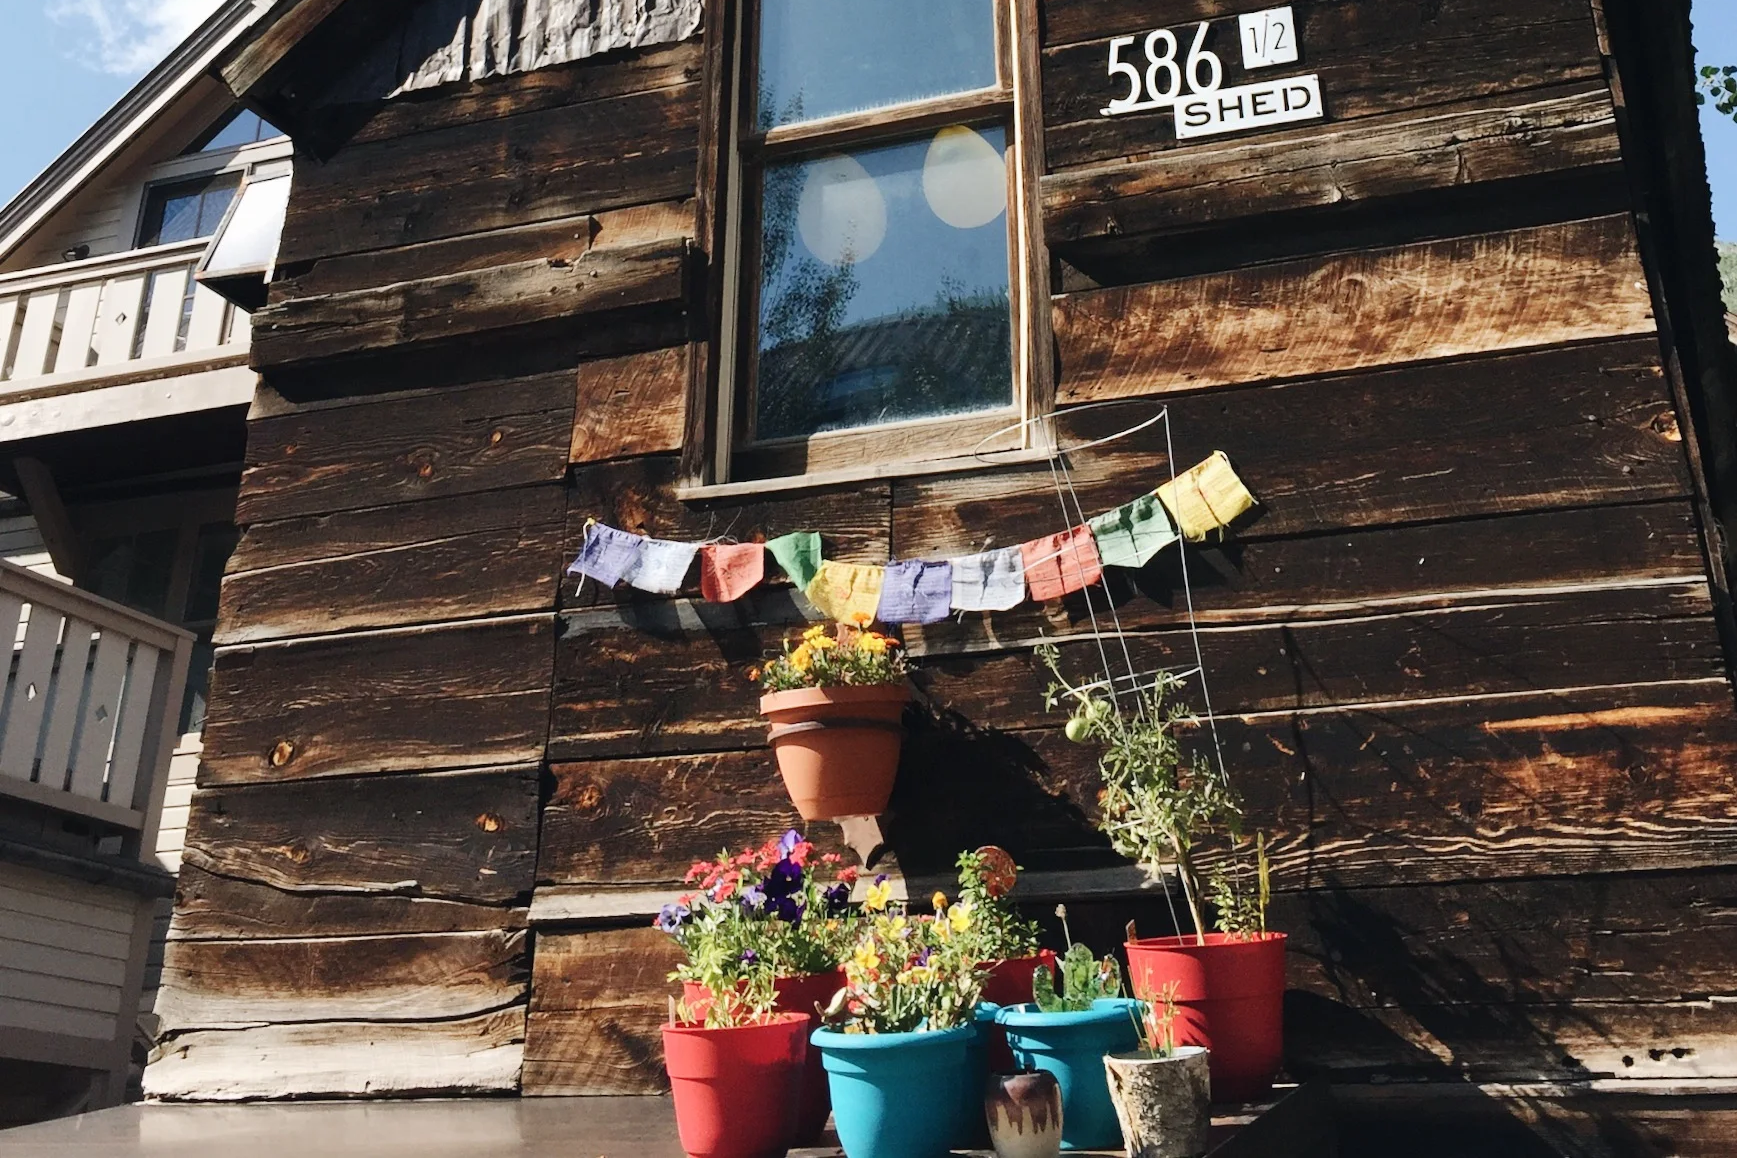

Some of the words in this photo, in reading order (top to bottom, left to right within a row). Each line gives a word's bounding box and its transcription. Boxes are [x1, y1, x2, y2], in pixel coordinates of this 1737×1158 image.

[1107, 21, 1223, 107] 586
[1248, 18, 1288, 58] 1/2
[1184, 86, 1311, 127] SHED
